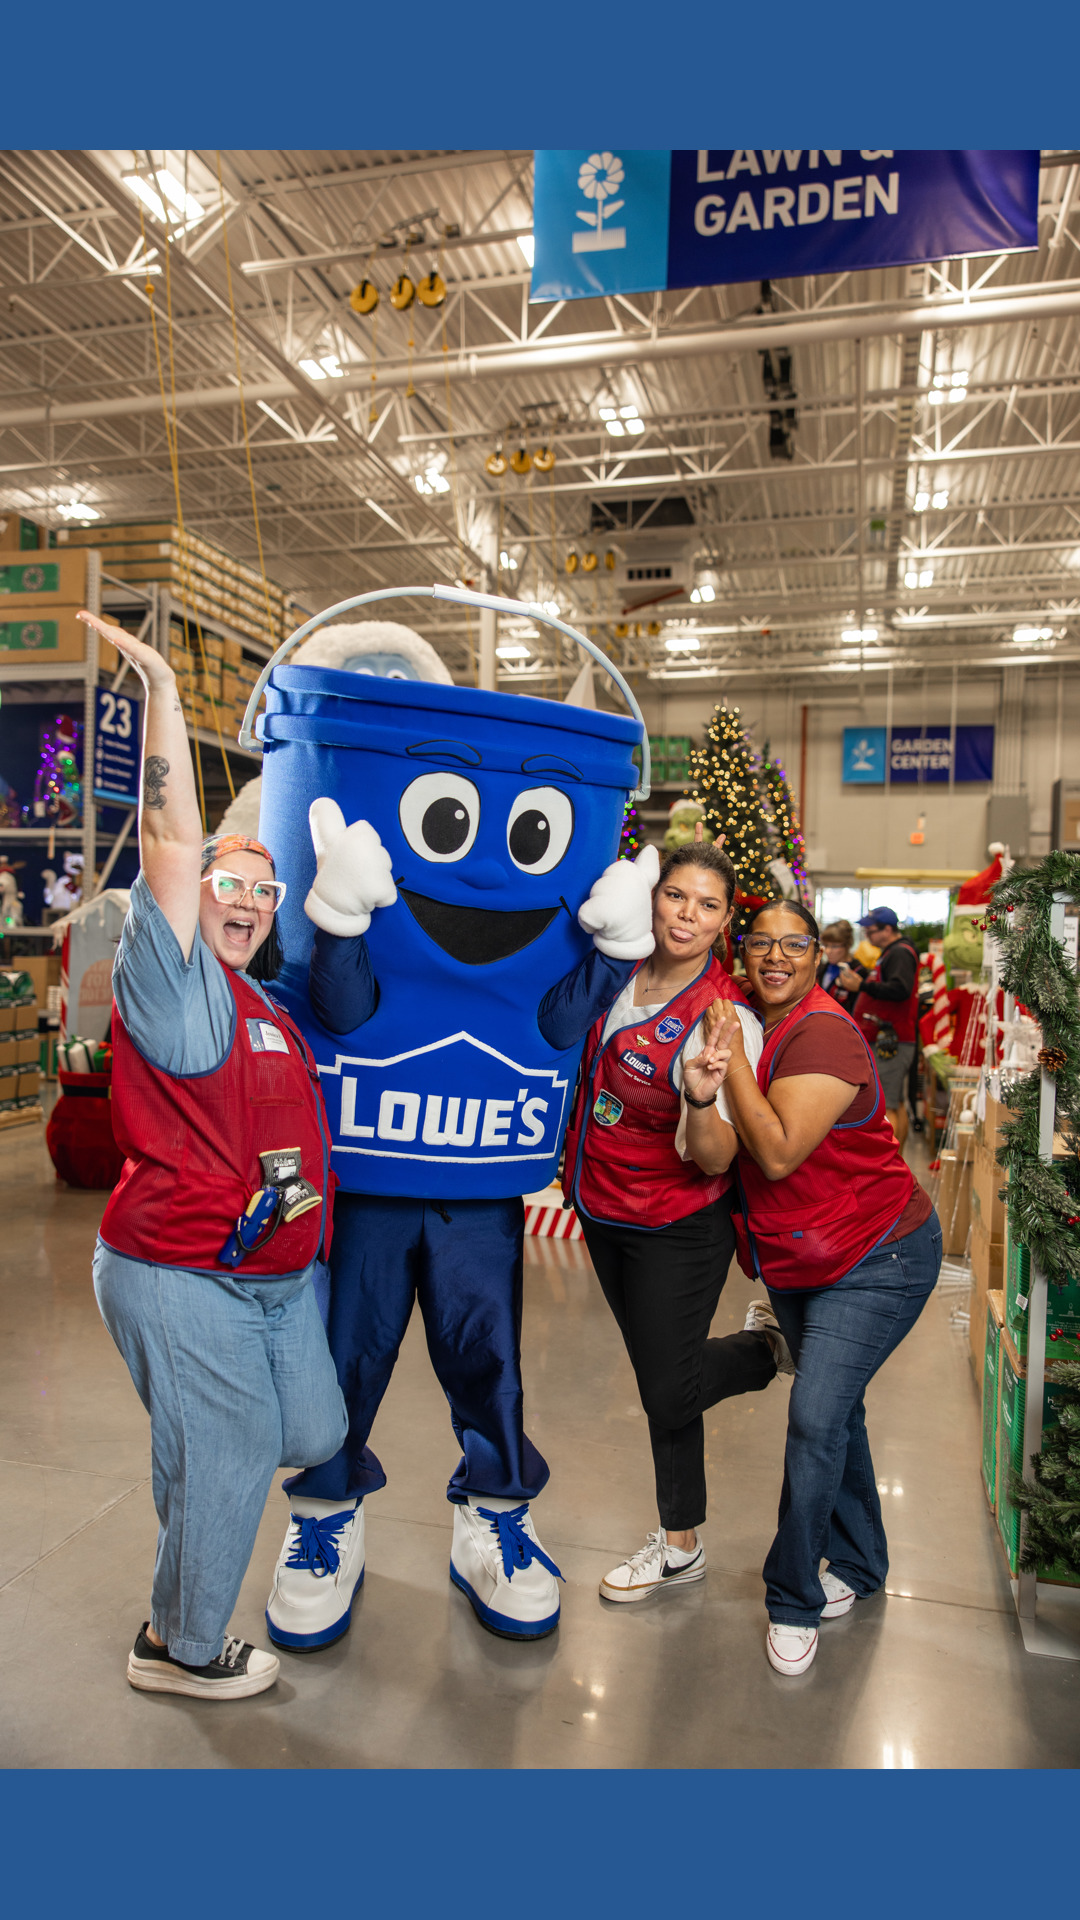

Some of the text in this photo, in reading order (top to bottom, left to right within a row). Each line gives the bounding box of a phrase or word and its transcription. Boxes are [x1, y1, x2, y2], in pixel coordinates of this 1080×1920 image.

[694, 171, 900, 237] GARDEN
[100, 692, 132, 738] 23
[892, 738, 953, 754] GARDEN
[891, 755, 951, 770] CENTER
[623, 1051, 654, 1076] LOWE'S
[633, 1075, 652, 1086] Service
[339, 1075, 549, 1147] LOWE'S
